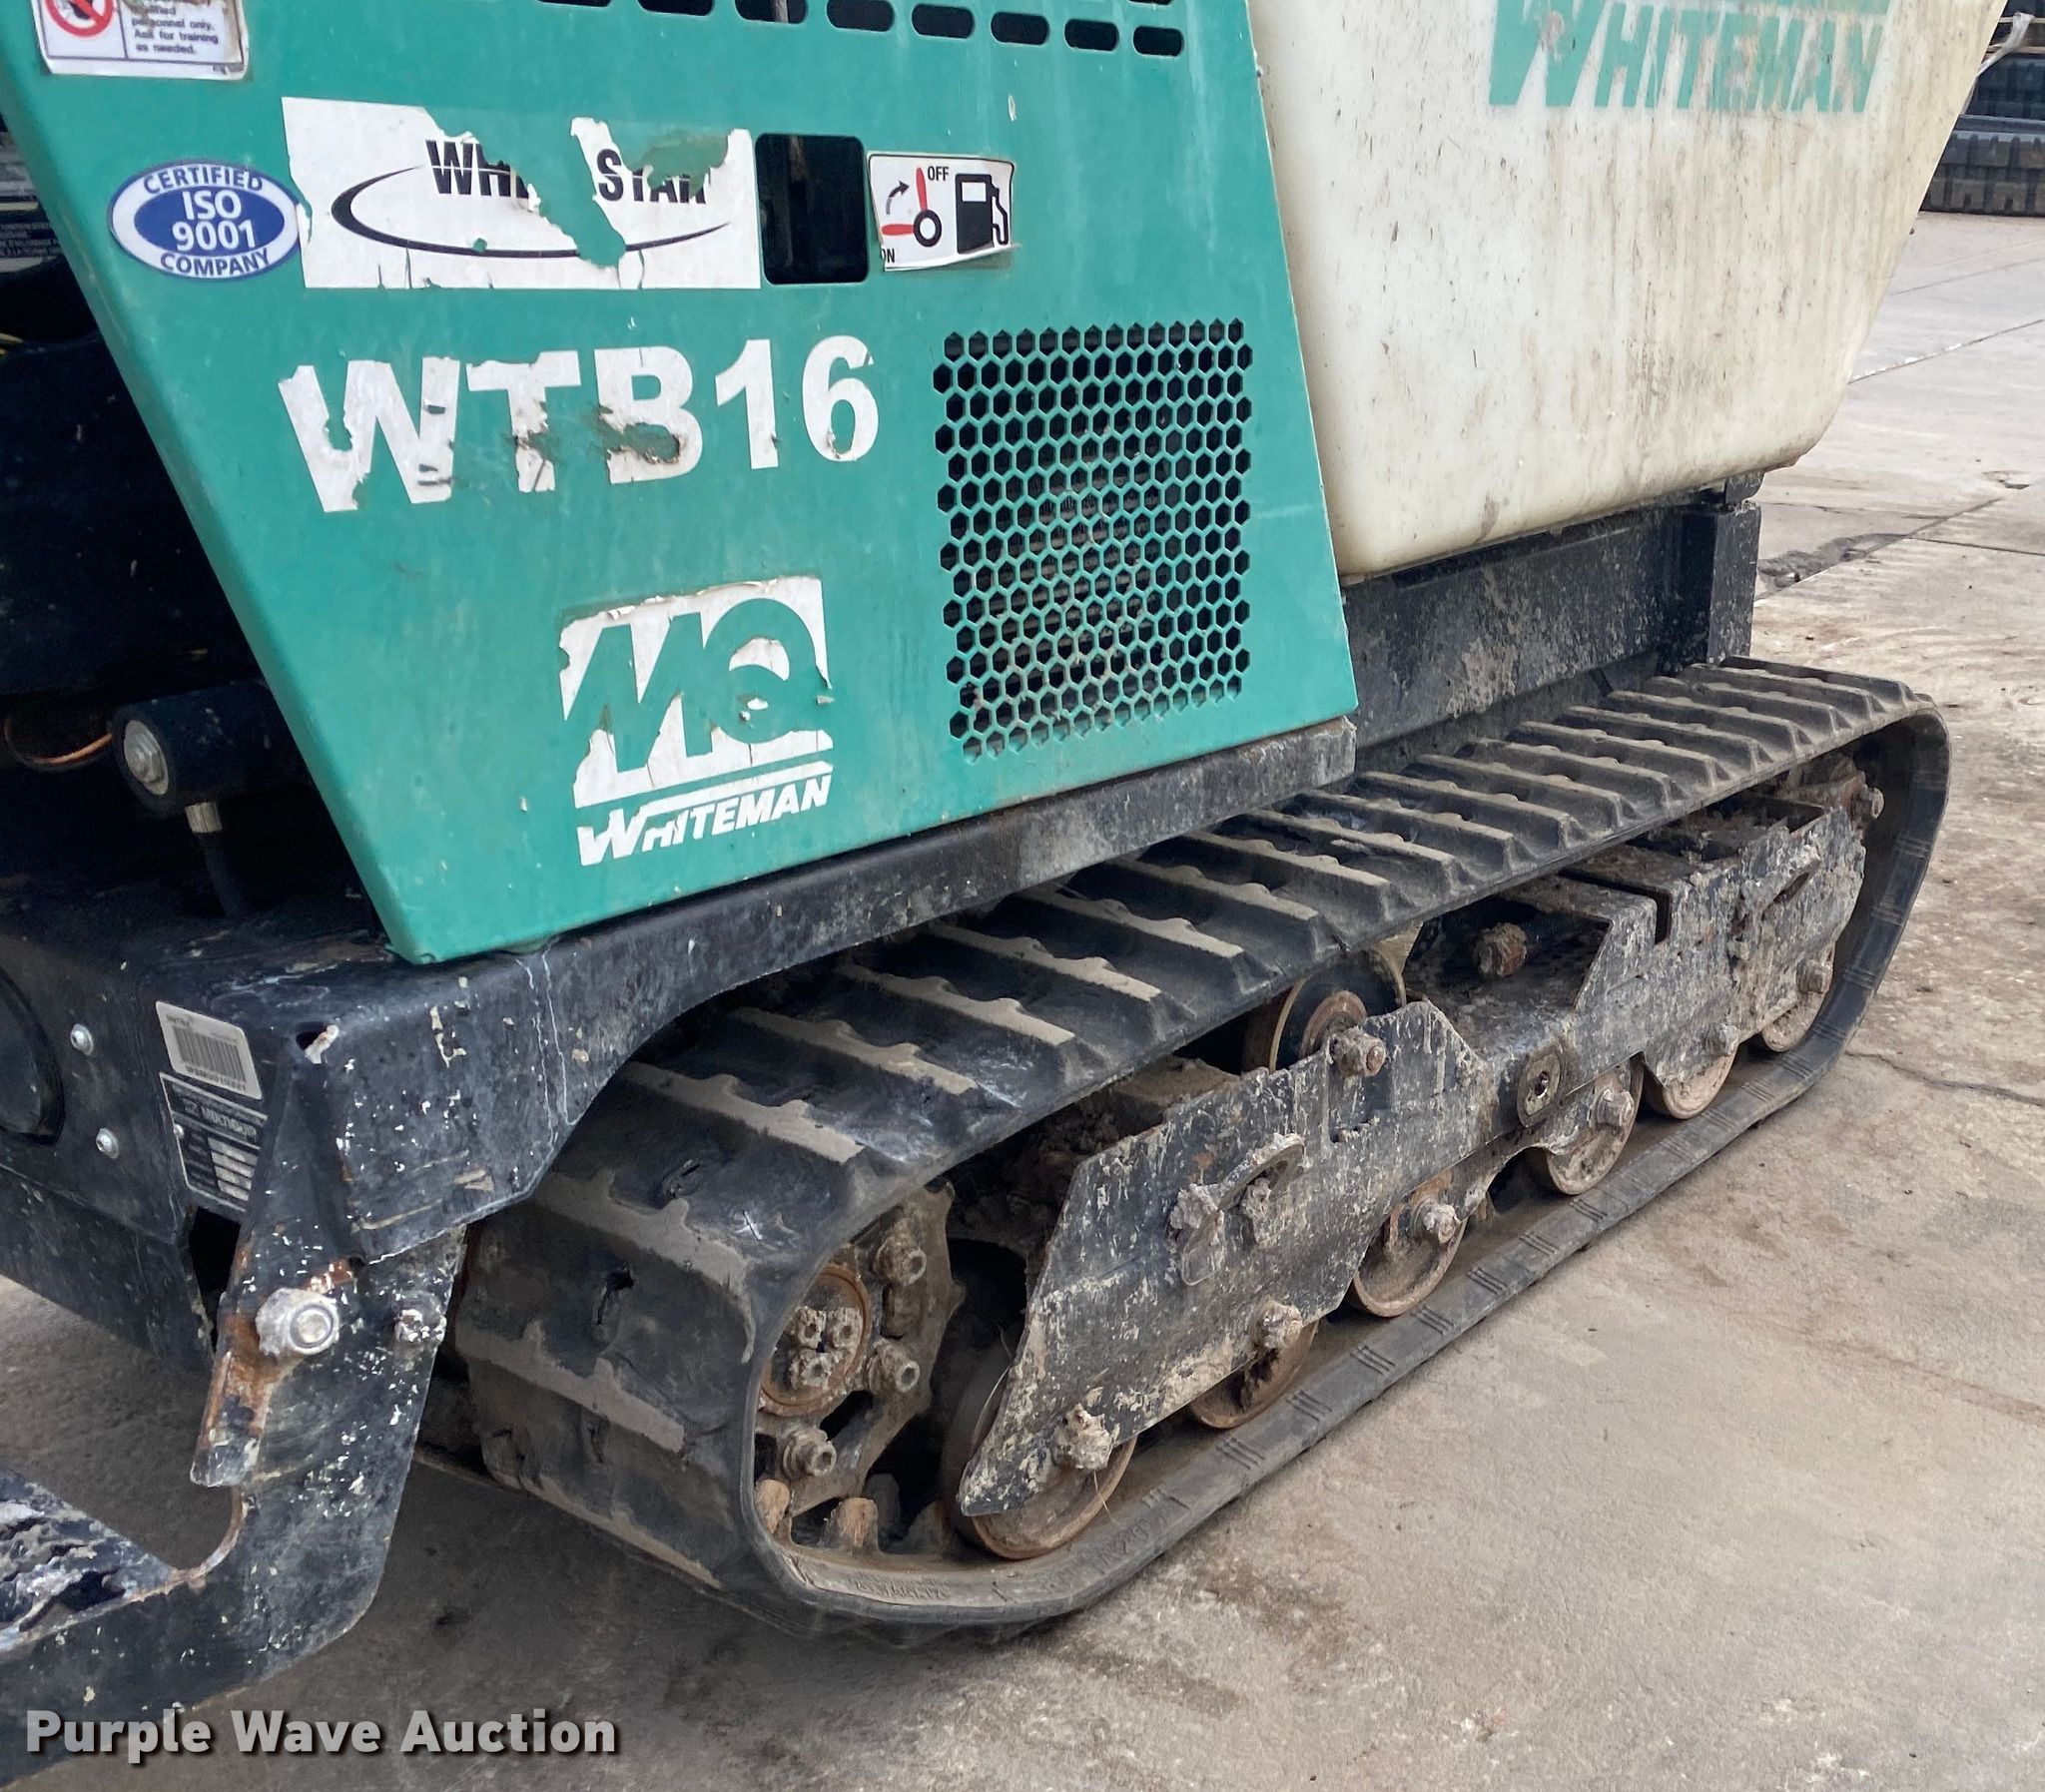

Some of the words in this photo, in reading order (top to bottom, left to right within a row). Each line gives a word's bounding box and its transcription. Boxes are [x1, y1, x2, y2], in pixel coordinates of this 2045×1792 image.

[180, 32, 219, 45] training
[144, 166, 263, 194] CERTIFIED
[927, 166, 950, 182] OFF
[181, 189, 242, 221] ISO
[172, 219, 256, 252] 9001
[160, 248, 271, 277] COMPANY
[278, 334, 880, 512] WTB16
[576, 773, 832, 867] WHITEMAN
